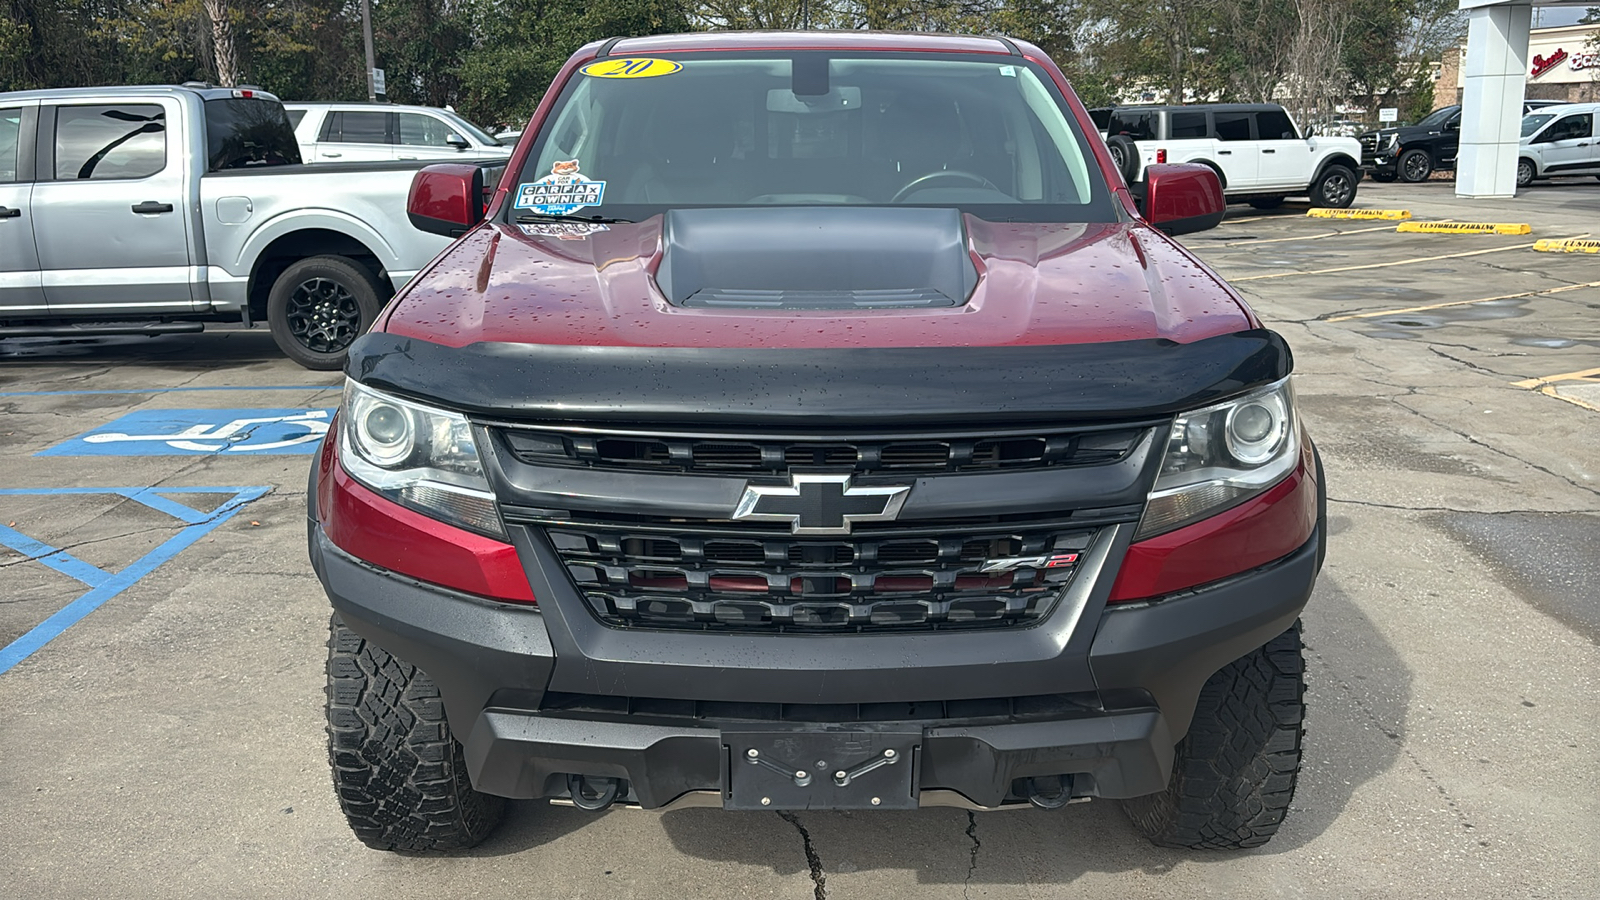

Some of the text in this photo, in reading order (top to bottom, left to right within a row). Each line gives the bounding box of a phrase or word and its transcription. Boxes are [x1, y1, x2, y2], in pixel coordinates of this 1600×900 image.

[600, 60, 654, 76] 20
[524, 184, 597, 195] CARFAX
[980, 554, 1079, 572] ZR2
